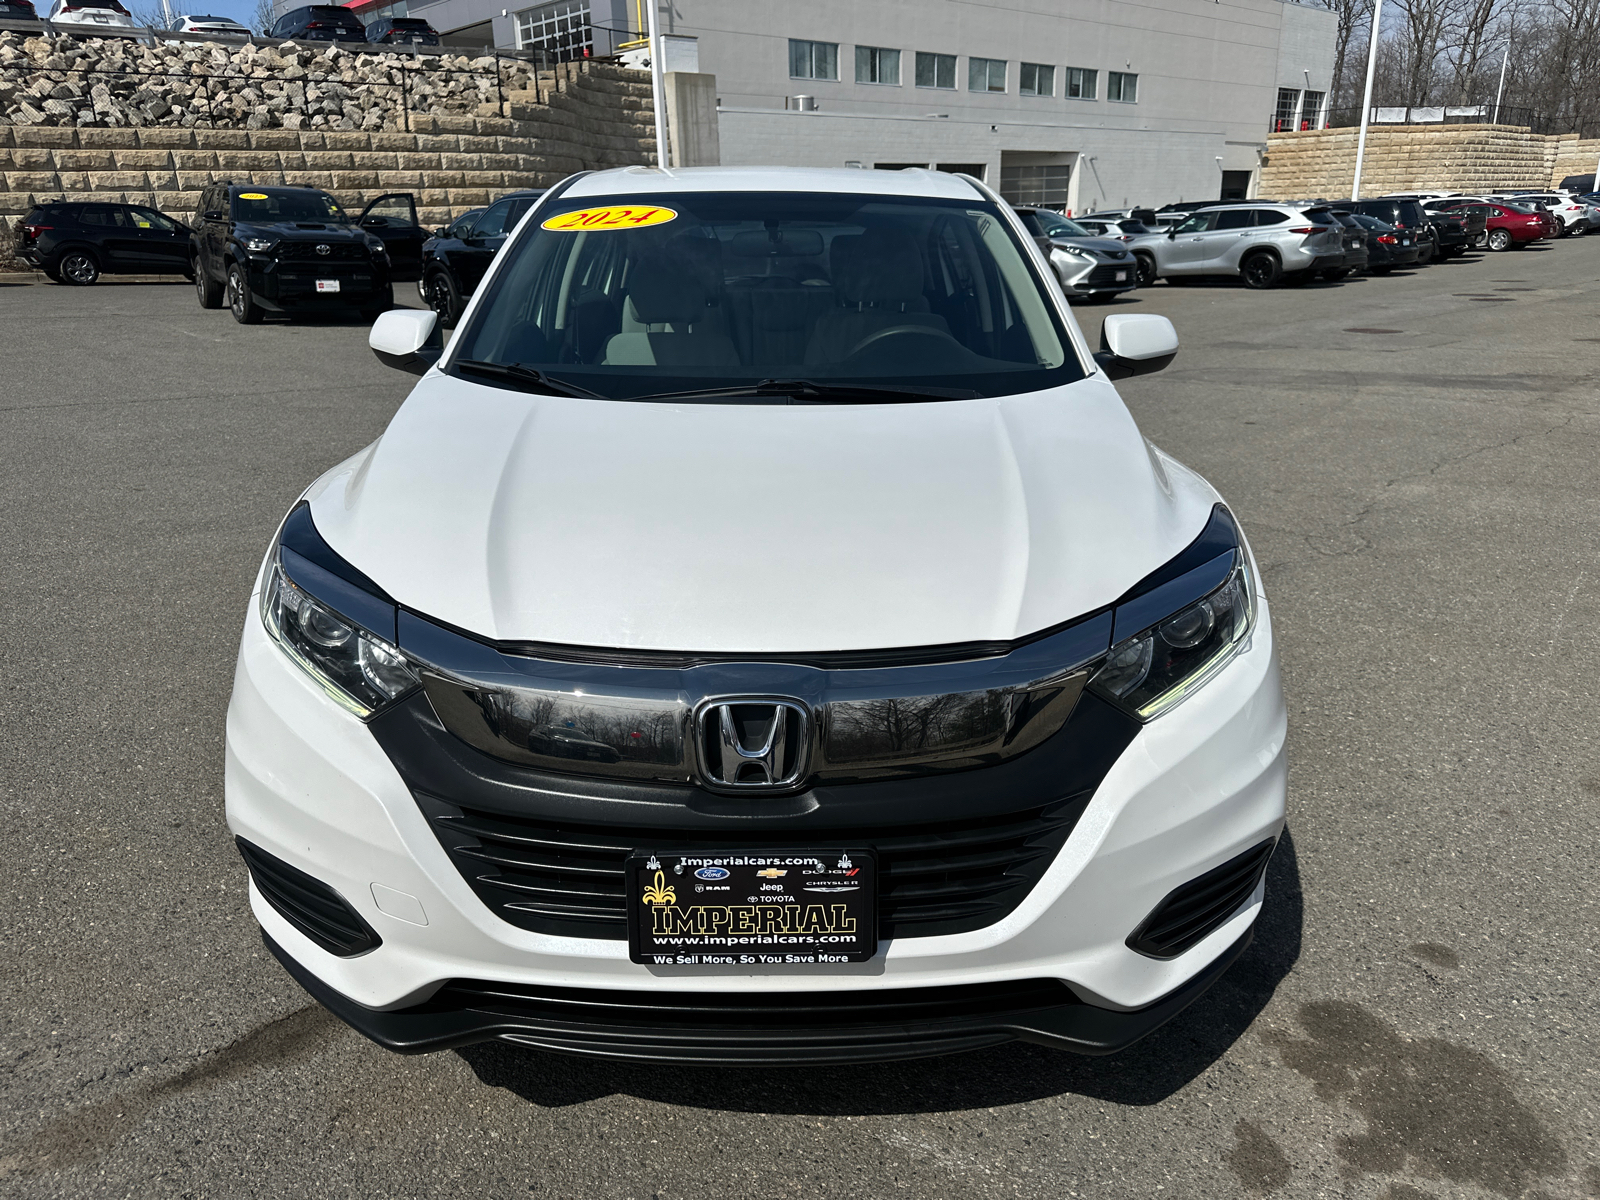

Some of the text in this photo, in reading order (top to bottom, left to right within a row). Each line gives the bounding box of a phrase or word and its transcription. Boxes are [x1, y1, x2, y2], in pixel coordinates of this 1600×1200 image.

[557, 209, 660, 228] 2024
[680, 856, 818, 867] Imperialcars.com
[702, 869, 722, 878] Ford
[760, 883, 783, 892] Jeep
[652, 904, 857, 935] IMPERIAL
[652, 935, 857, 946] www.imperialcars.com
[653, 954, 849, 965] We Sell More, So You Save More
